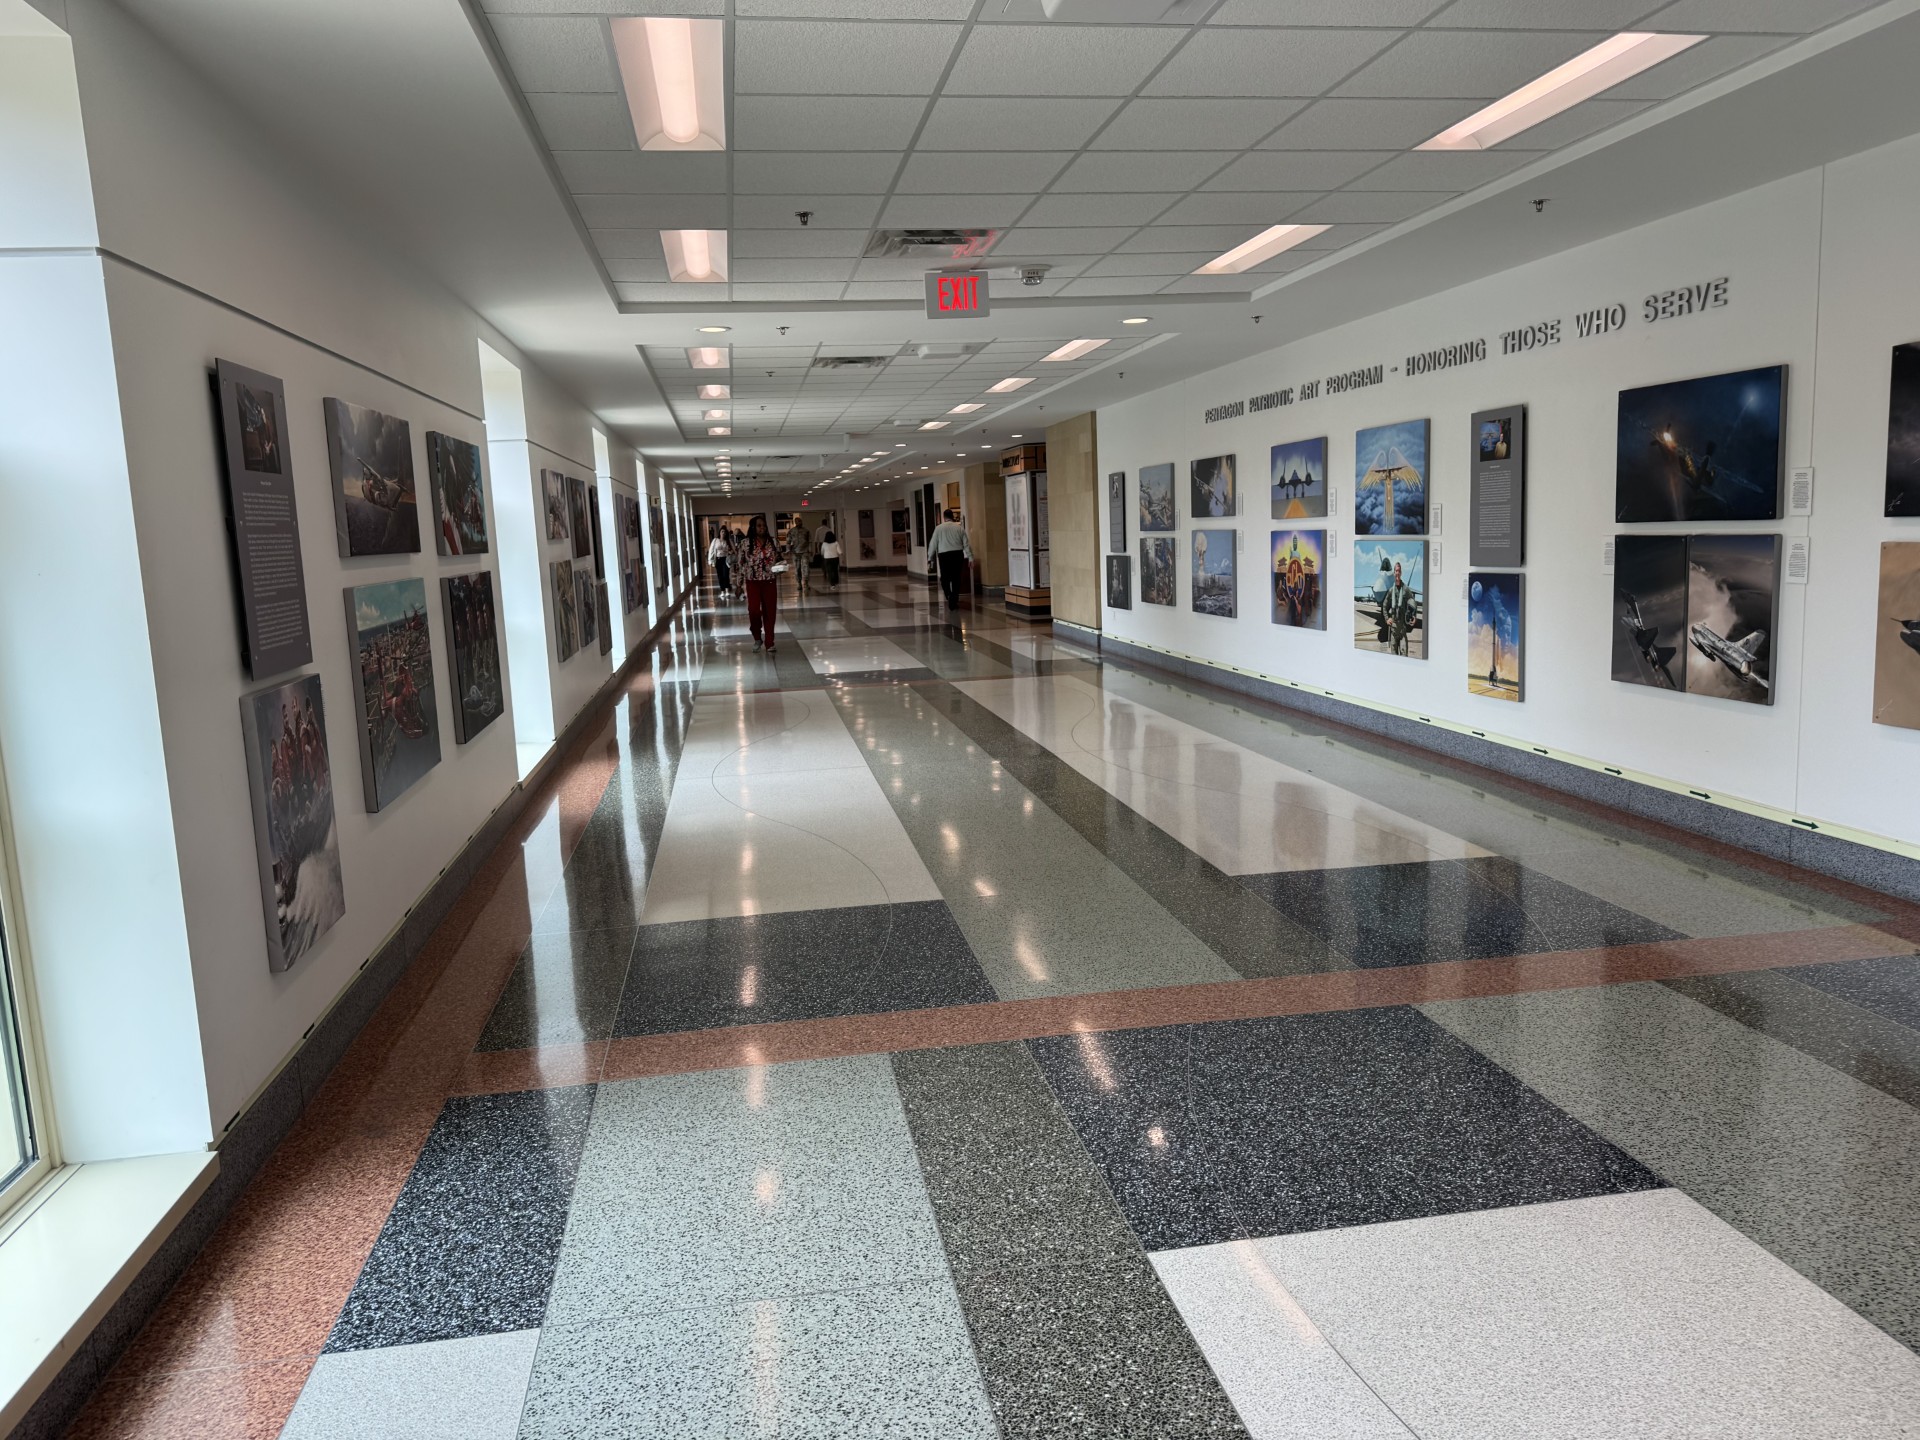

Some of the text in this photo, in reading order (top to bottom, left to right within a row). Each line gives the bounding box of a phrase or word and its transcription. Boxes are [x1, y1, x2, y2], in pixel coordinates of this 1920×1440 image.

[937, 276, 979, 311] EXIT
[1204, 400, 1244, 424] PENTAGON
[1248, 387, 1294, 413] PATRIOTIC
[1299, 379, 1321, 402] ART
[1326, 363, 1384, 395] PROGRAM
[1405, 338, 1486, 377] HONORING
[1499, 319, 1561, 355] THOSE
[1575, 303, 1627, 338] WHO
[1643, 277, 1729, 323] SERVE
